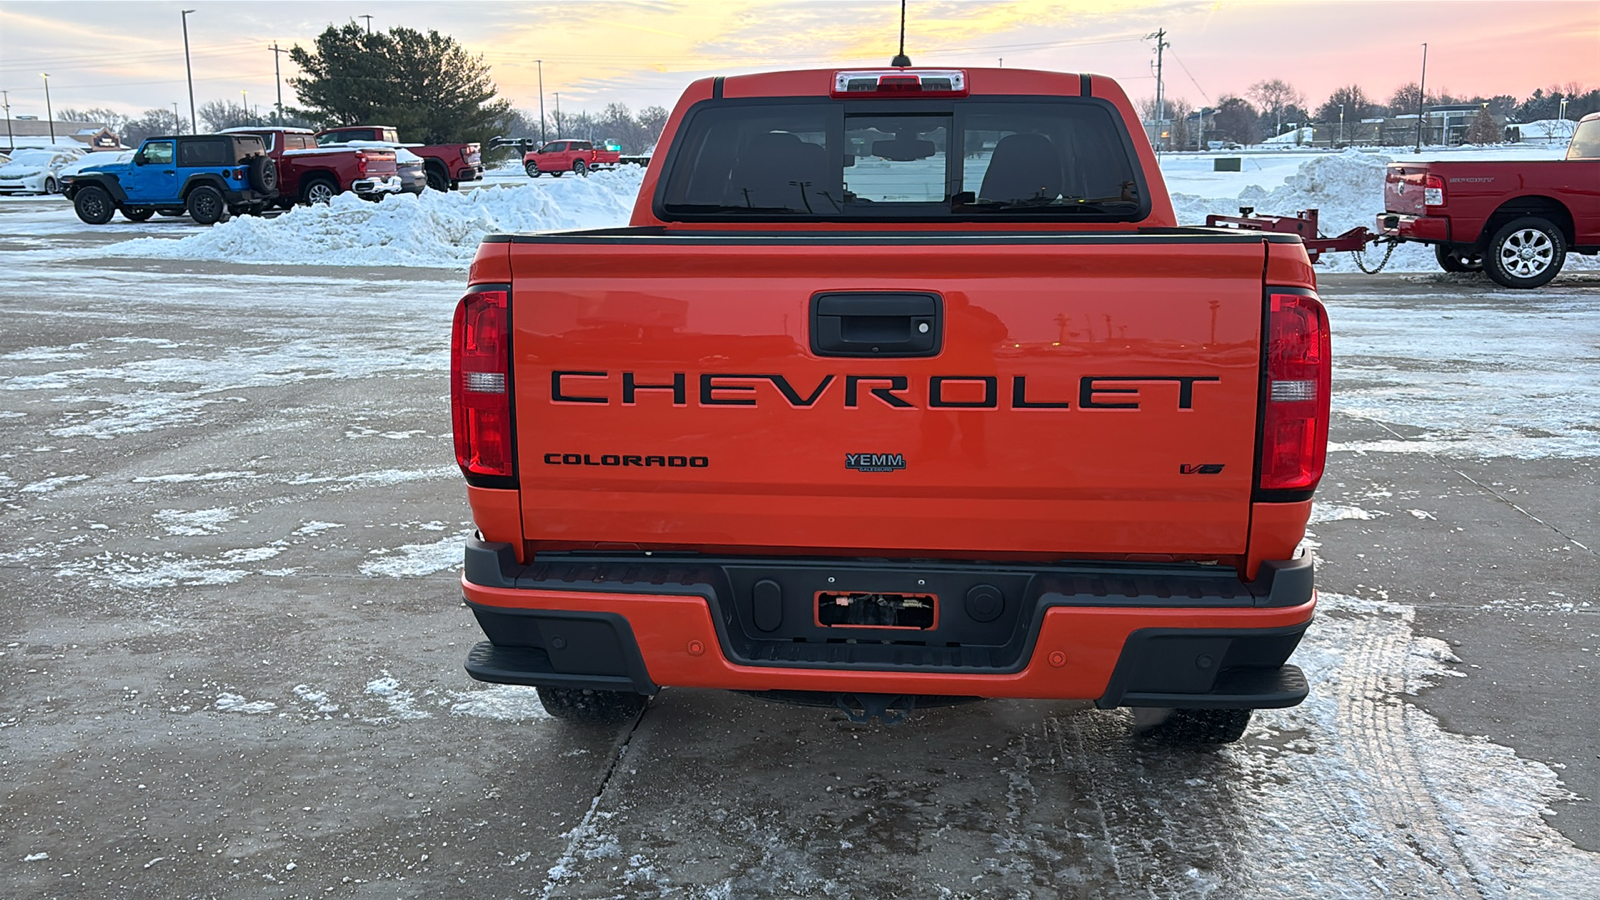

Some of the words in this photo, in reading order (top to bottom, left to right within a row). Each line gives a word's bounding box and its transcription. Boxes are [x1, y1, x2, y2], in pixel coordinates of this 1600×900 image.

[550, 370, 1221, 411] CHEVROLET
[544, 453, 708, 468] COLORADO
[846, 453, 903, 466] YEMM
